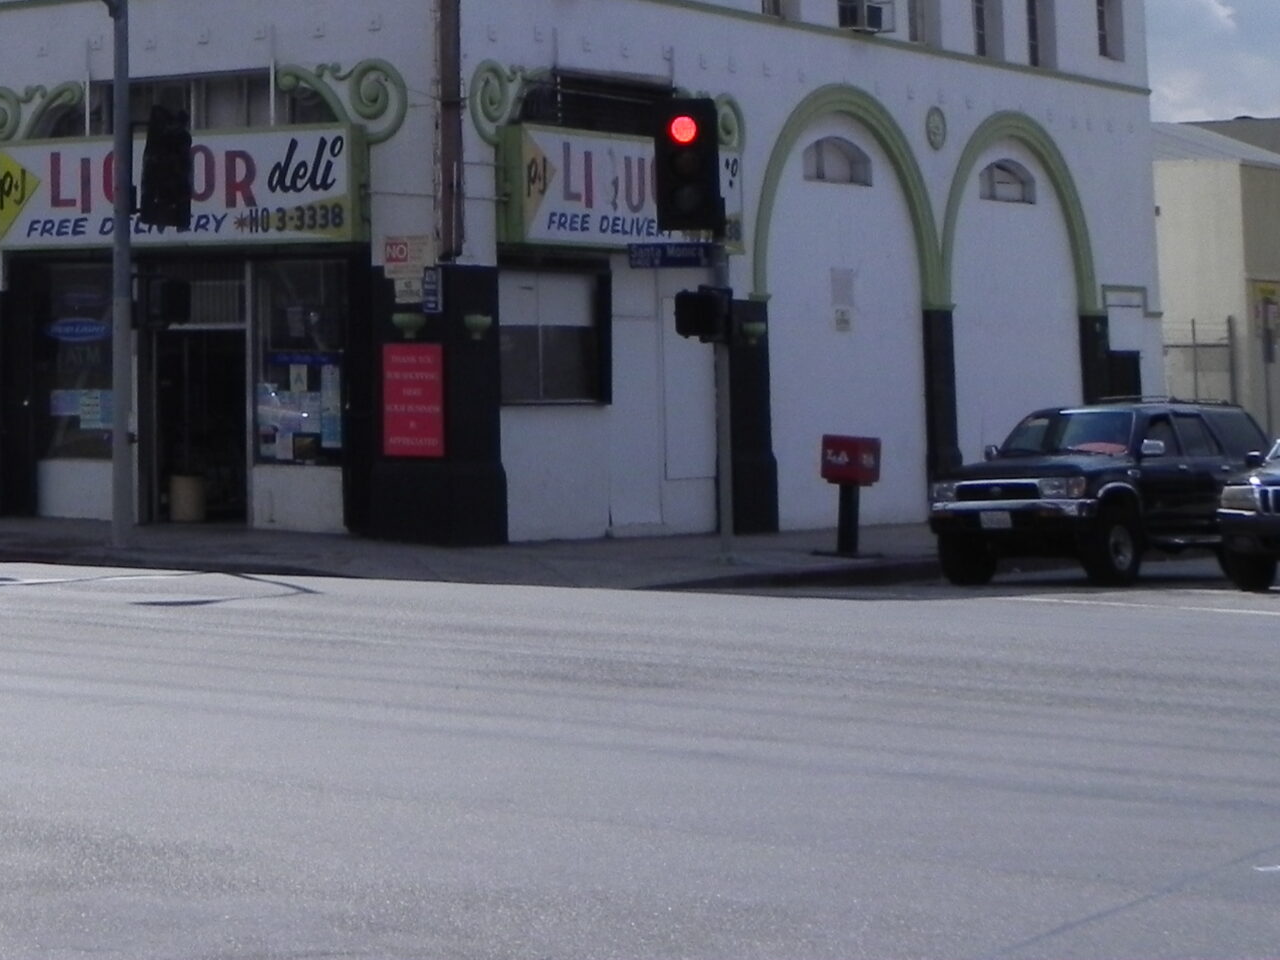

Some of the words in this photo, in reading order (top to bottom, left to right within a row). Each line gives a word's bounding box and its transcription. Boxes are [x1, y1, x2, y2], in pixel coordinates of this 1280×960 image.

[50, 144, 258, 214] LIOR
[267, 135, 344, 193] deli
[26, 216, 88, 238] FREE
[99, 212, 228, 236] DLIRY
[275, 203, 344, 232] 3-3338
[547, 211, 592, 232] FREE
[386, 244, 407, 259] NO
[631, 244, 661, 258] Santa
[666, 243, 705, 258] Monica
